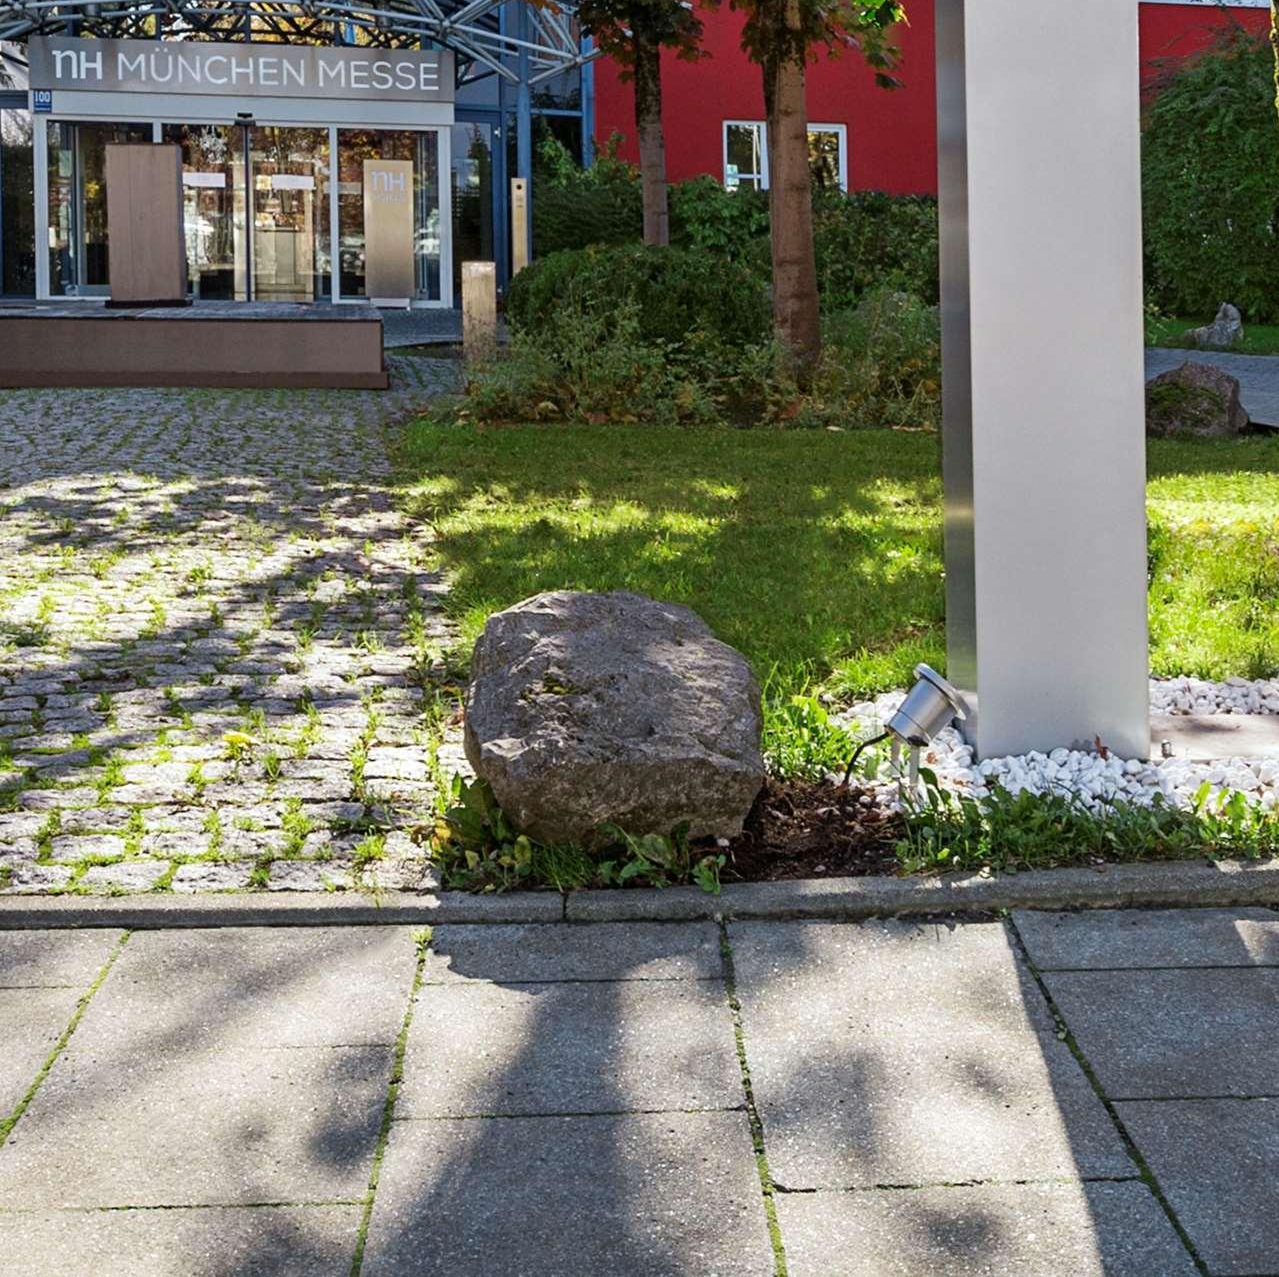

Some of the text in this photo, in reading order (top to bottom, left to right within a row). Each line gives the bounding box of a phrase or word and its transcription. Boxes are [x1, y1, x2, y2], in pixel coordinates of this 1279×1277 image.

[52, 47, 440, 91] nH MÜNCHEN MESSE
[34, 91, 51, 103] 100
